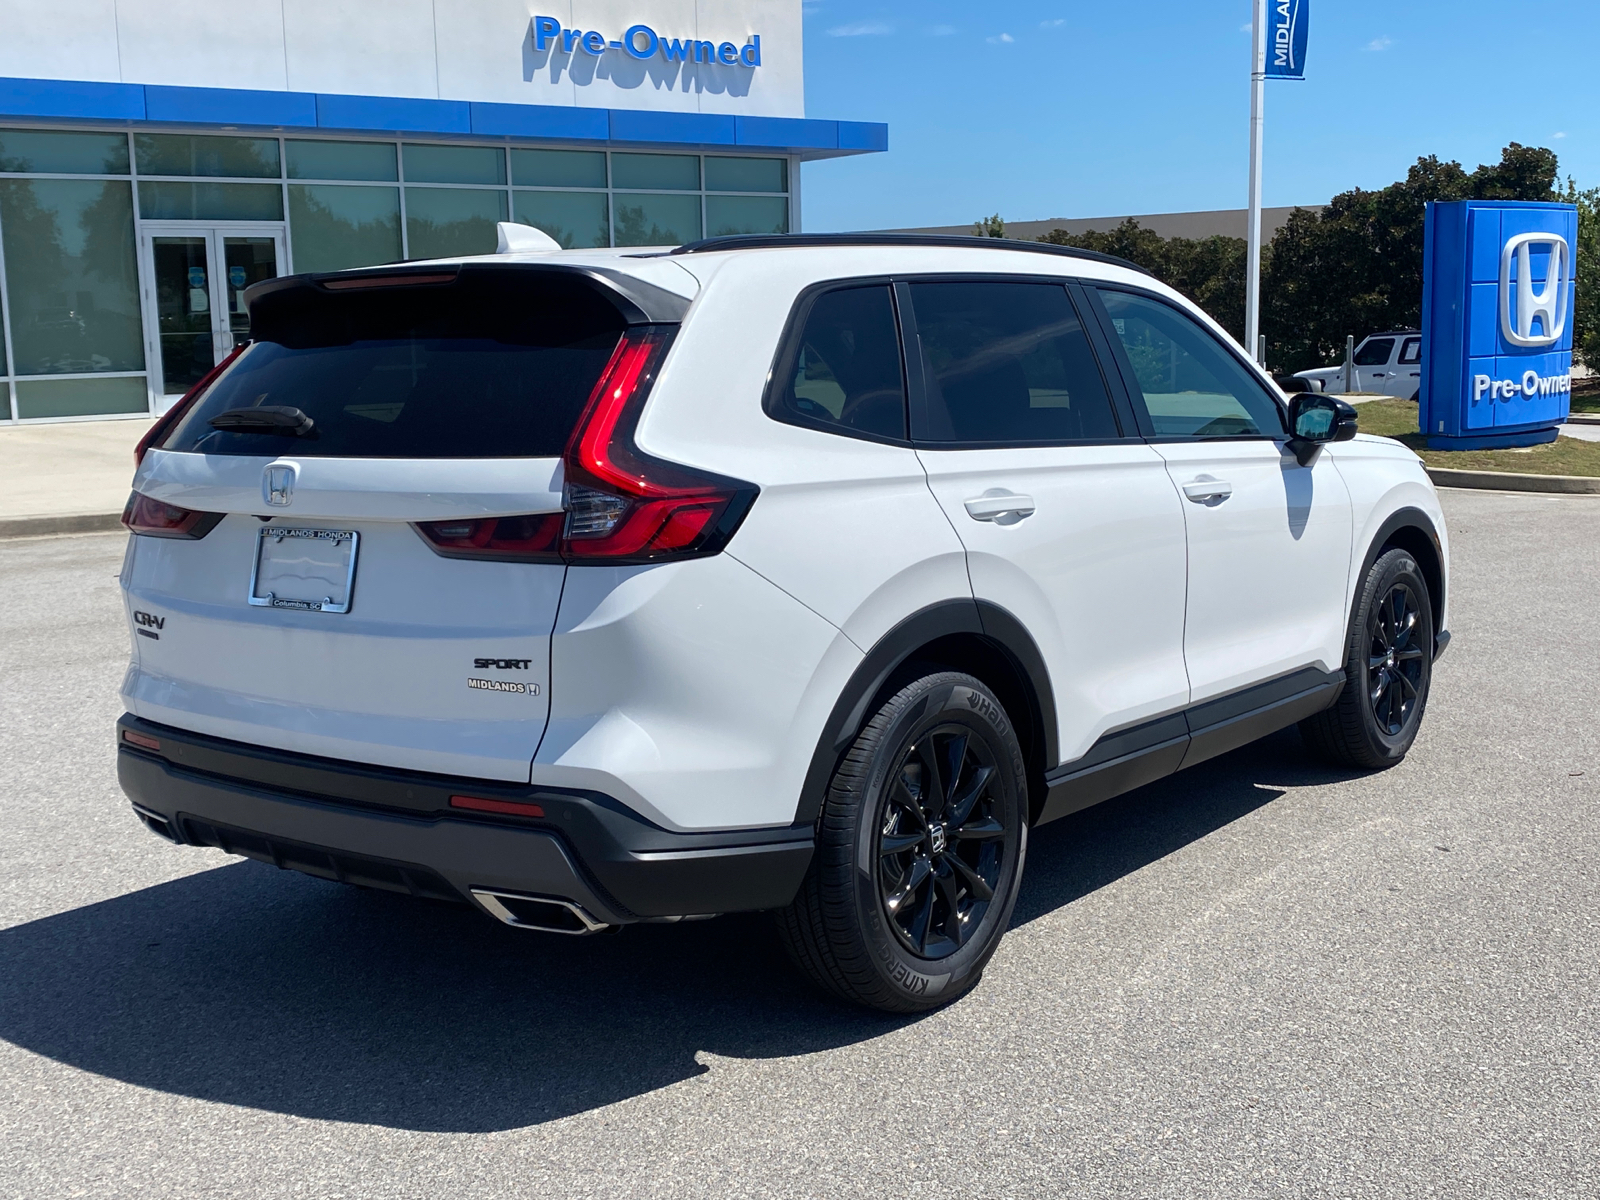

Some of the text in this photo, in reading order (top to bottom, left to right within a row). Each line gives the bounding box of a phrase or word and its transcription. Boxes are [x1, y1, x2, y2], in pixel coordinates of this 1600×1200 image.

[532, 15, 761, 67] Pre-Owned
[1274, 0, 1290, 65] MIDLA
[1474, 367, 1571, 400] Pre-Owned
[269, 528, 351, 539] MIDLANDS HONDA
[274, 599, 308, 609] Columbia,
[133, 610, 165, 630] CR-V
[474, 658, 532, 670] SPORT
[468, 678, 525, 693] MIDLANDS
